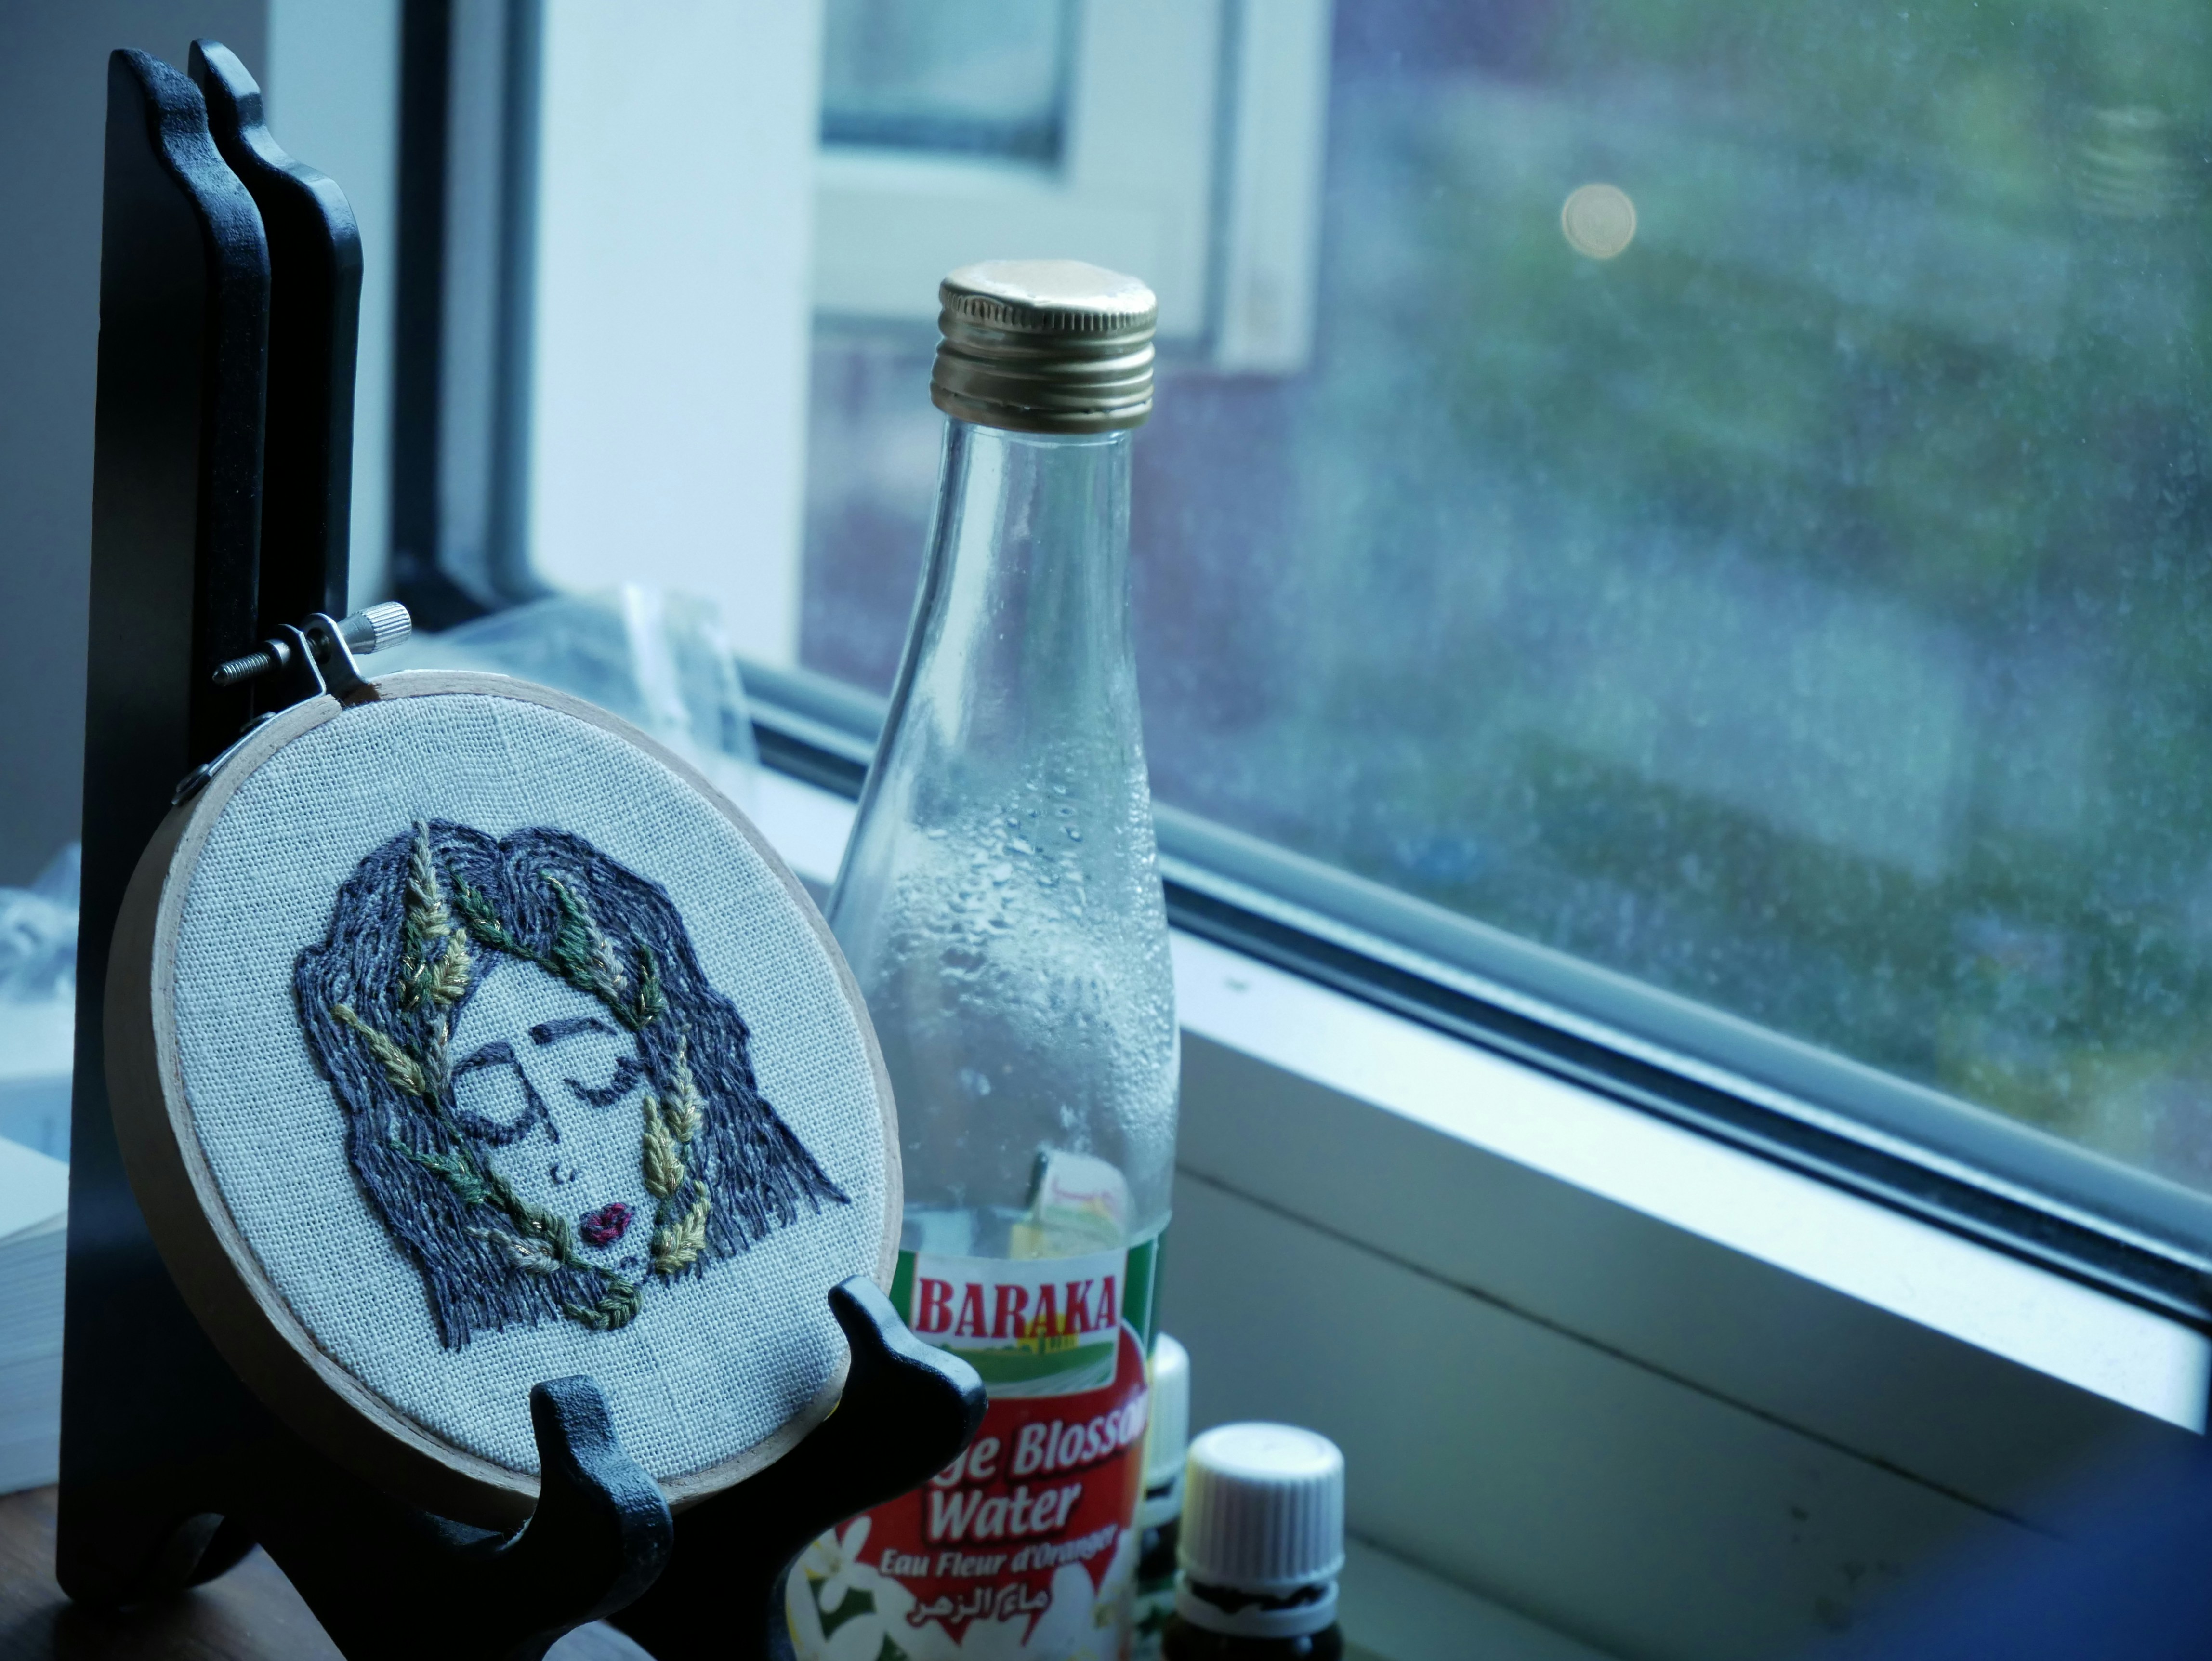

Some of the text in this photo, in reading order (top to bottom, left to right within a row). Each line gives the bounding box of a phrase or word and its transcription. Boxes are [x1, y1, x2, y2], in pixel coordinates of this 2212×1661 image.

[915, 1275, 1116, 1338] BARAKA
[931, 1483, 1082, 1540] Water
[881, 1548, 930, 1577] Eau
[936, 1552, 1007, 1577] Fleur
[912, 1586, 993, 1624] الزهر
